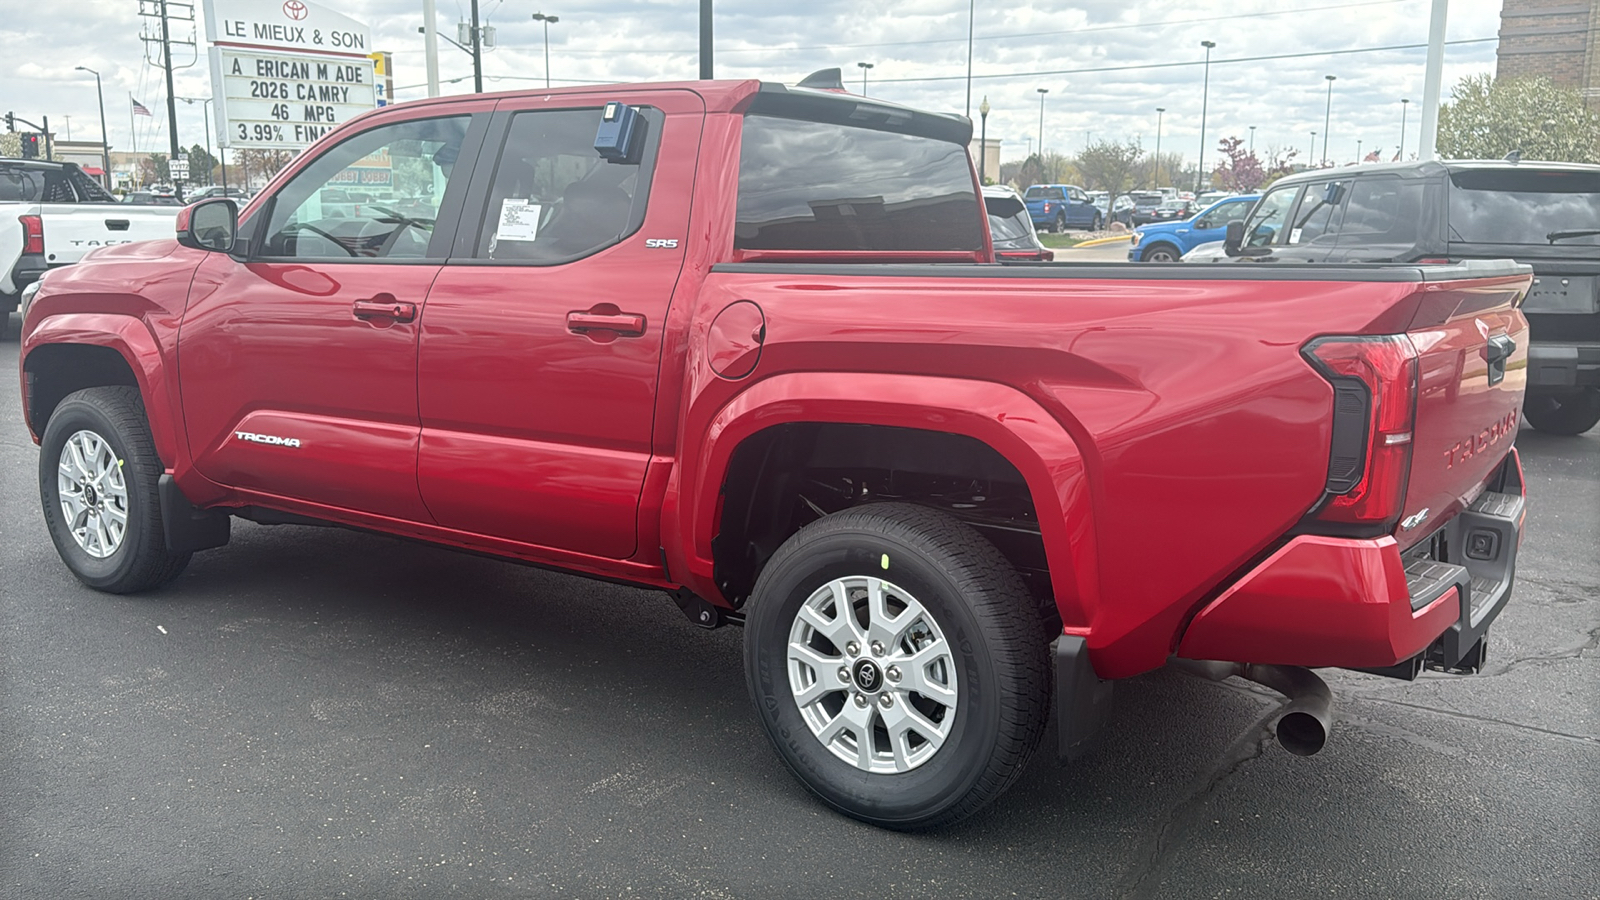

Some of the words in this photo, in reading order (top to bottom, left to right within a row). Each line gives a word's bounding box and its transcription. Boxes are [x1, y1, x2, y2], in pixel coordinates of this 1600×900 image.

[225, 20, 246, 38] LE
[254, 23, 305, 43] MIEUX
[313, 29, 324, 45] &
[331, 31, 364, 49] SON
[232, 58, 242, 75] A
[250, 80, 289, 99] 2026
[296, 83, 349, 103] CAMRY
[271, 103, 289, 120] 46
[304, 105, 335, 122] MPG
[238, 123, 283, 142] 3.99%
[295, 125, 334, 142] FINA
[645, 239, 678, 248] SR5
[234, 431, 301, 448] TACOMA
[1444, 407, 1517, 469] TACOMA
